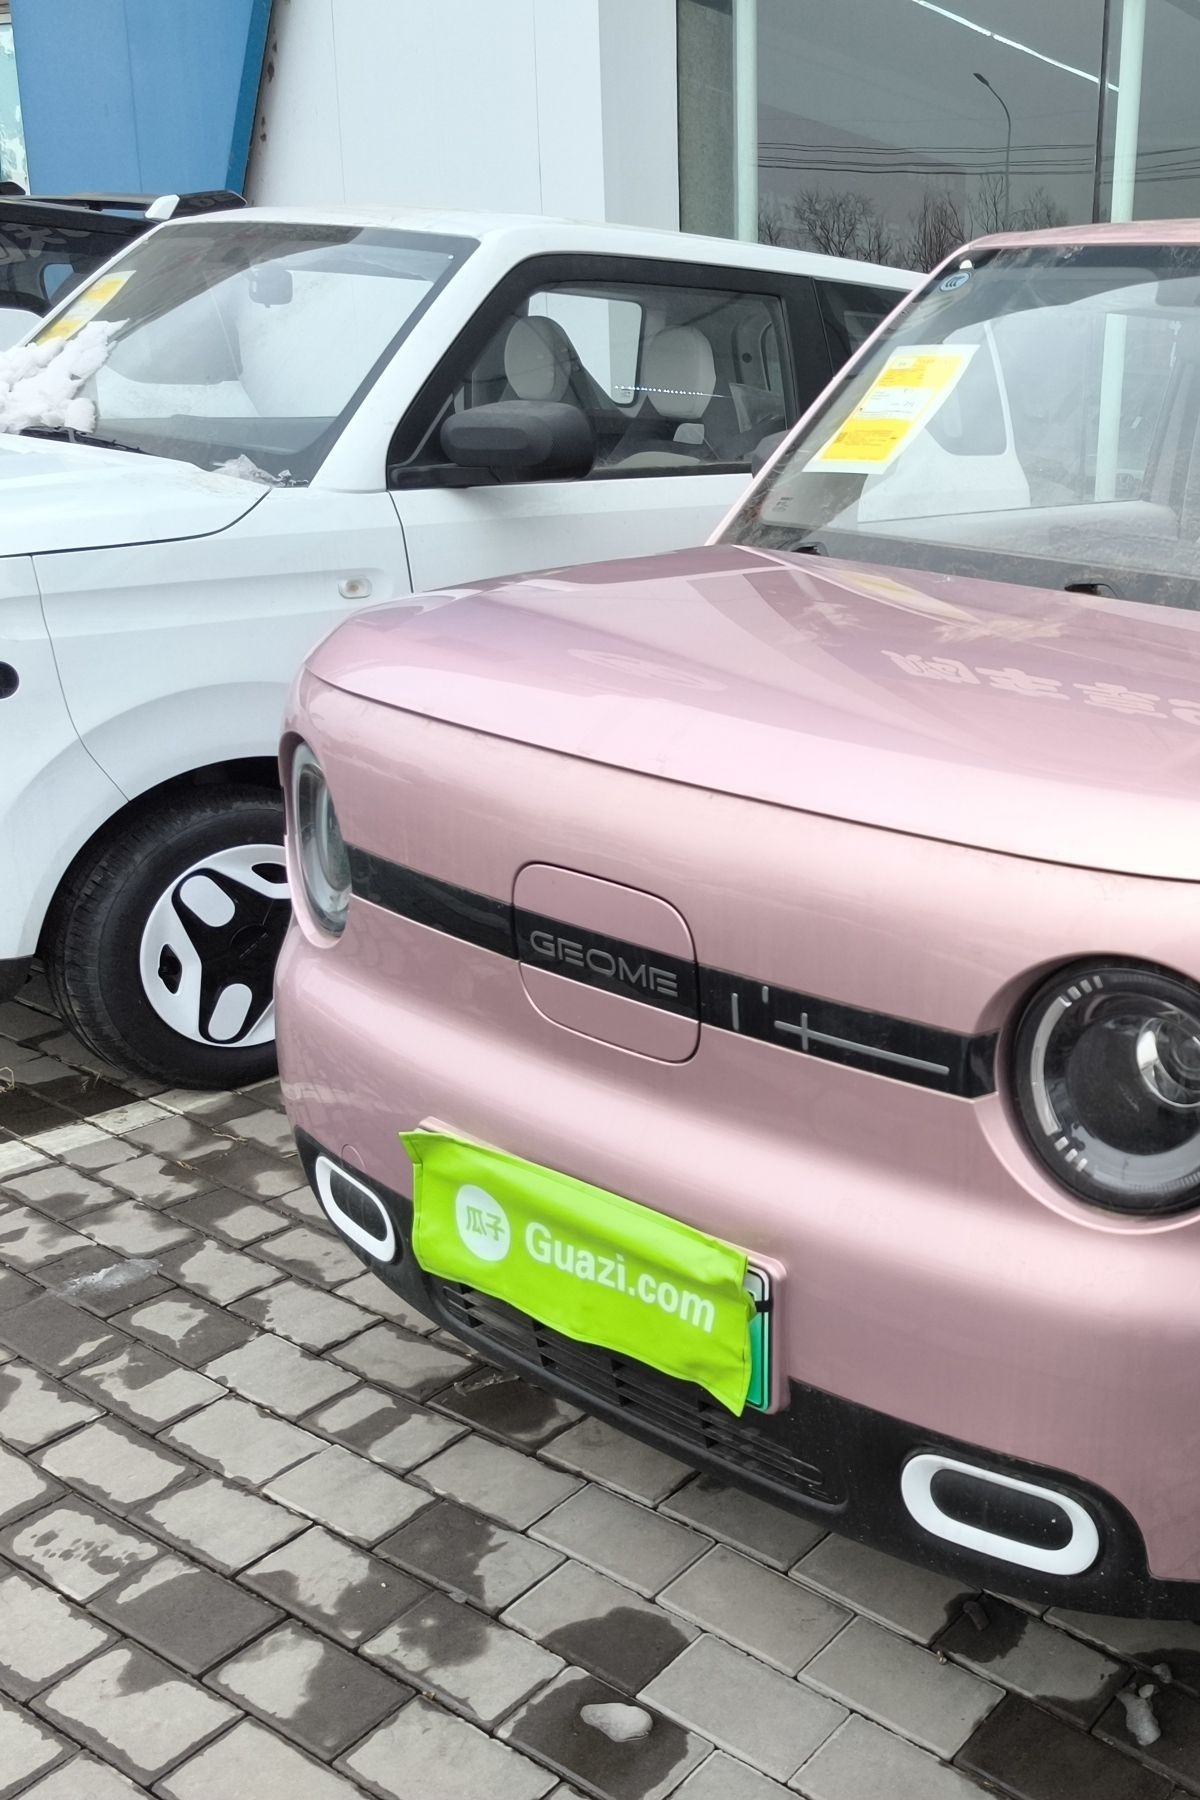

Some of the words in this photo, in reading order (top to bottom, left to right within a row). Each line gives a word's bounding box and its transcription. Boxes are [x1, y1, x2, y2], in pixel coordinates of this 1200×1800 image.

[529, 929, 678, 997] GEOME
[465, 1204, 505, 1242] 瓜子
[524, 1221, 716, 1334] Guazi.com
